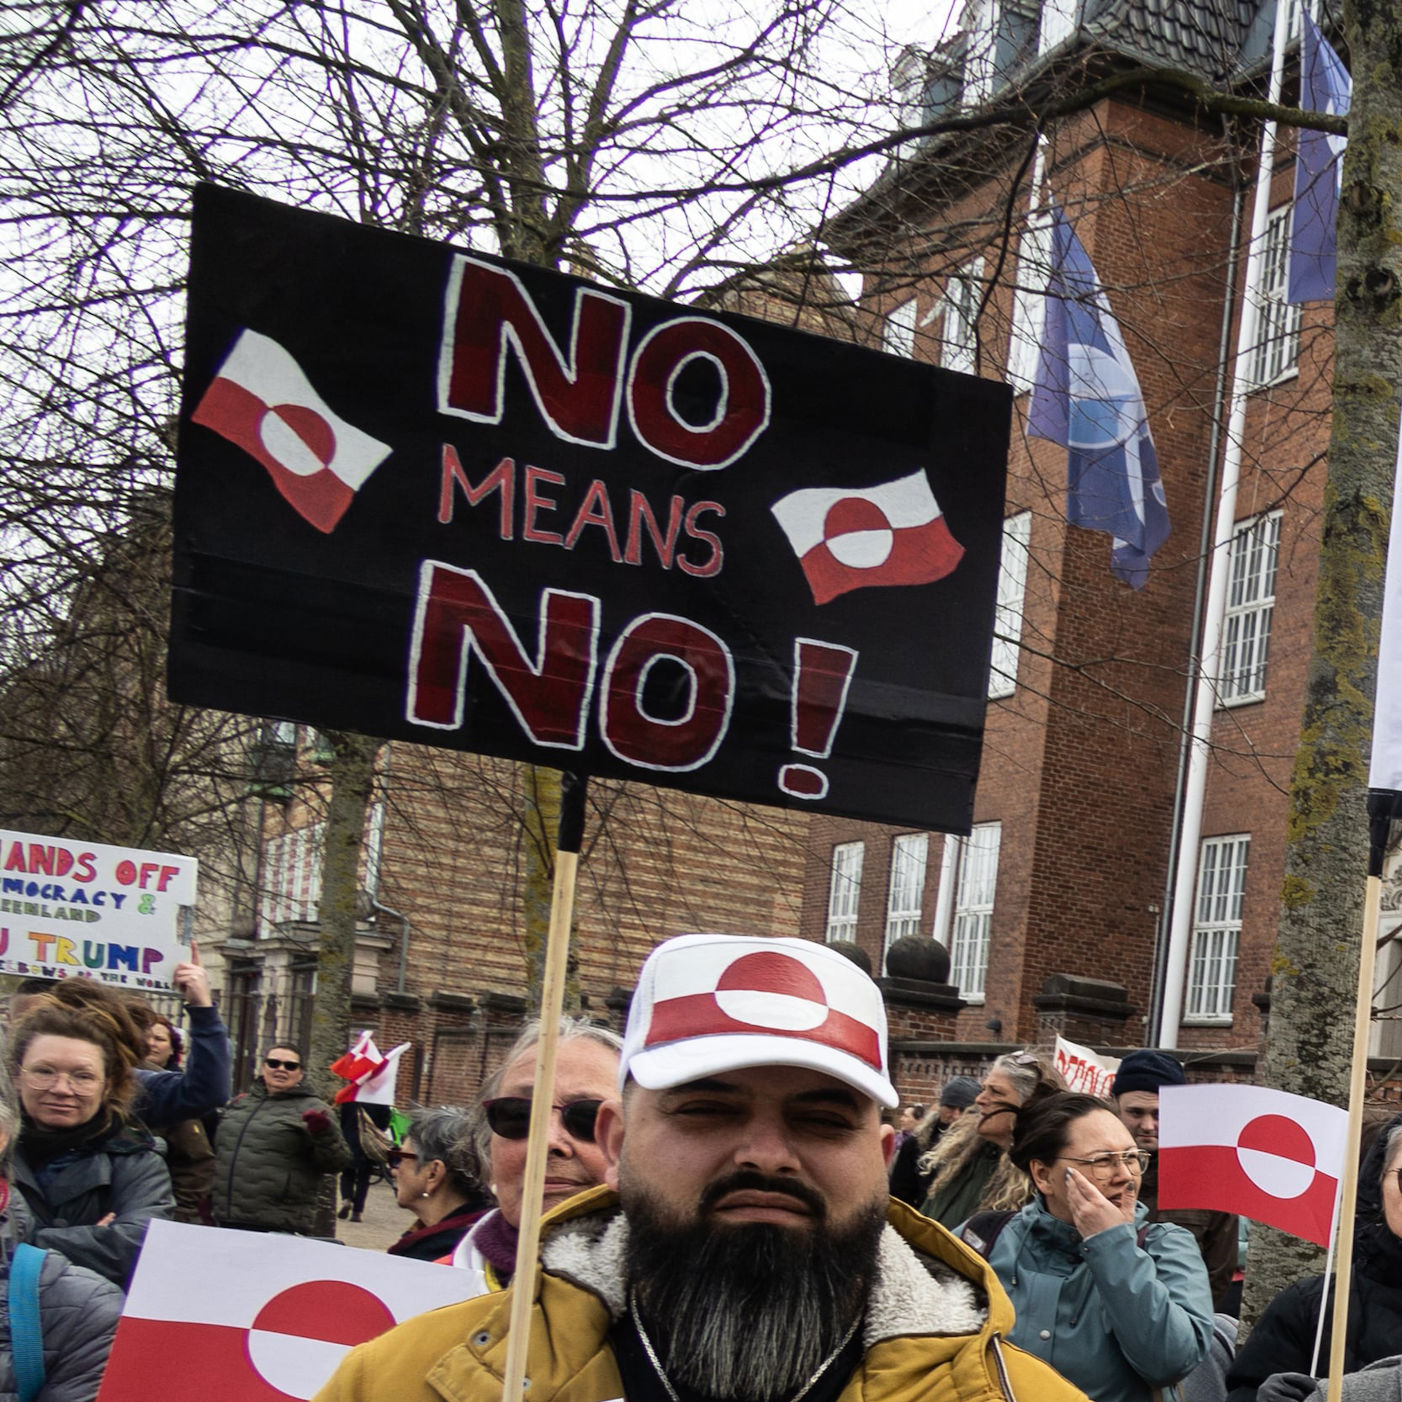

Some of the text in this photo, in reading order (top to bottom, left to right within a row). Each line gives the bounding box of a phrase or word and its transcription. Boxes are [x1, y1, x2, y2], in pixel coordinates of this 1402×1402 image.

[437, 253, 772, 471] NO
[438, 443, 728, 579] MEANS
[0, 838, 181, 893] ANDS OFF
[0, 876, 157, 916] MOCRACY &
[28, 931, 164, 975] TRUMP
